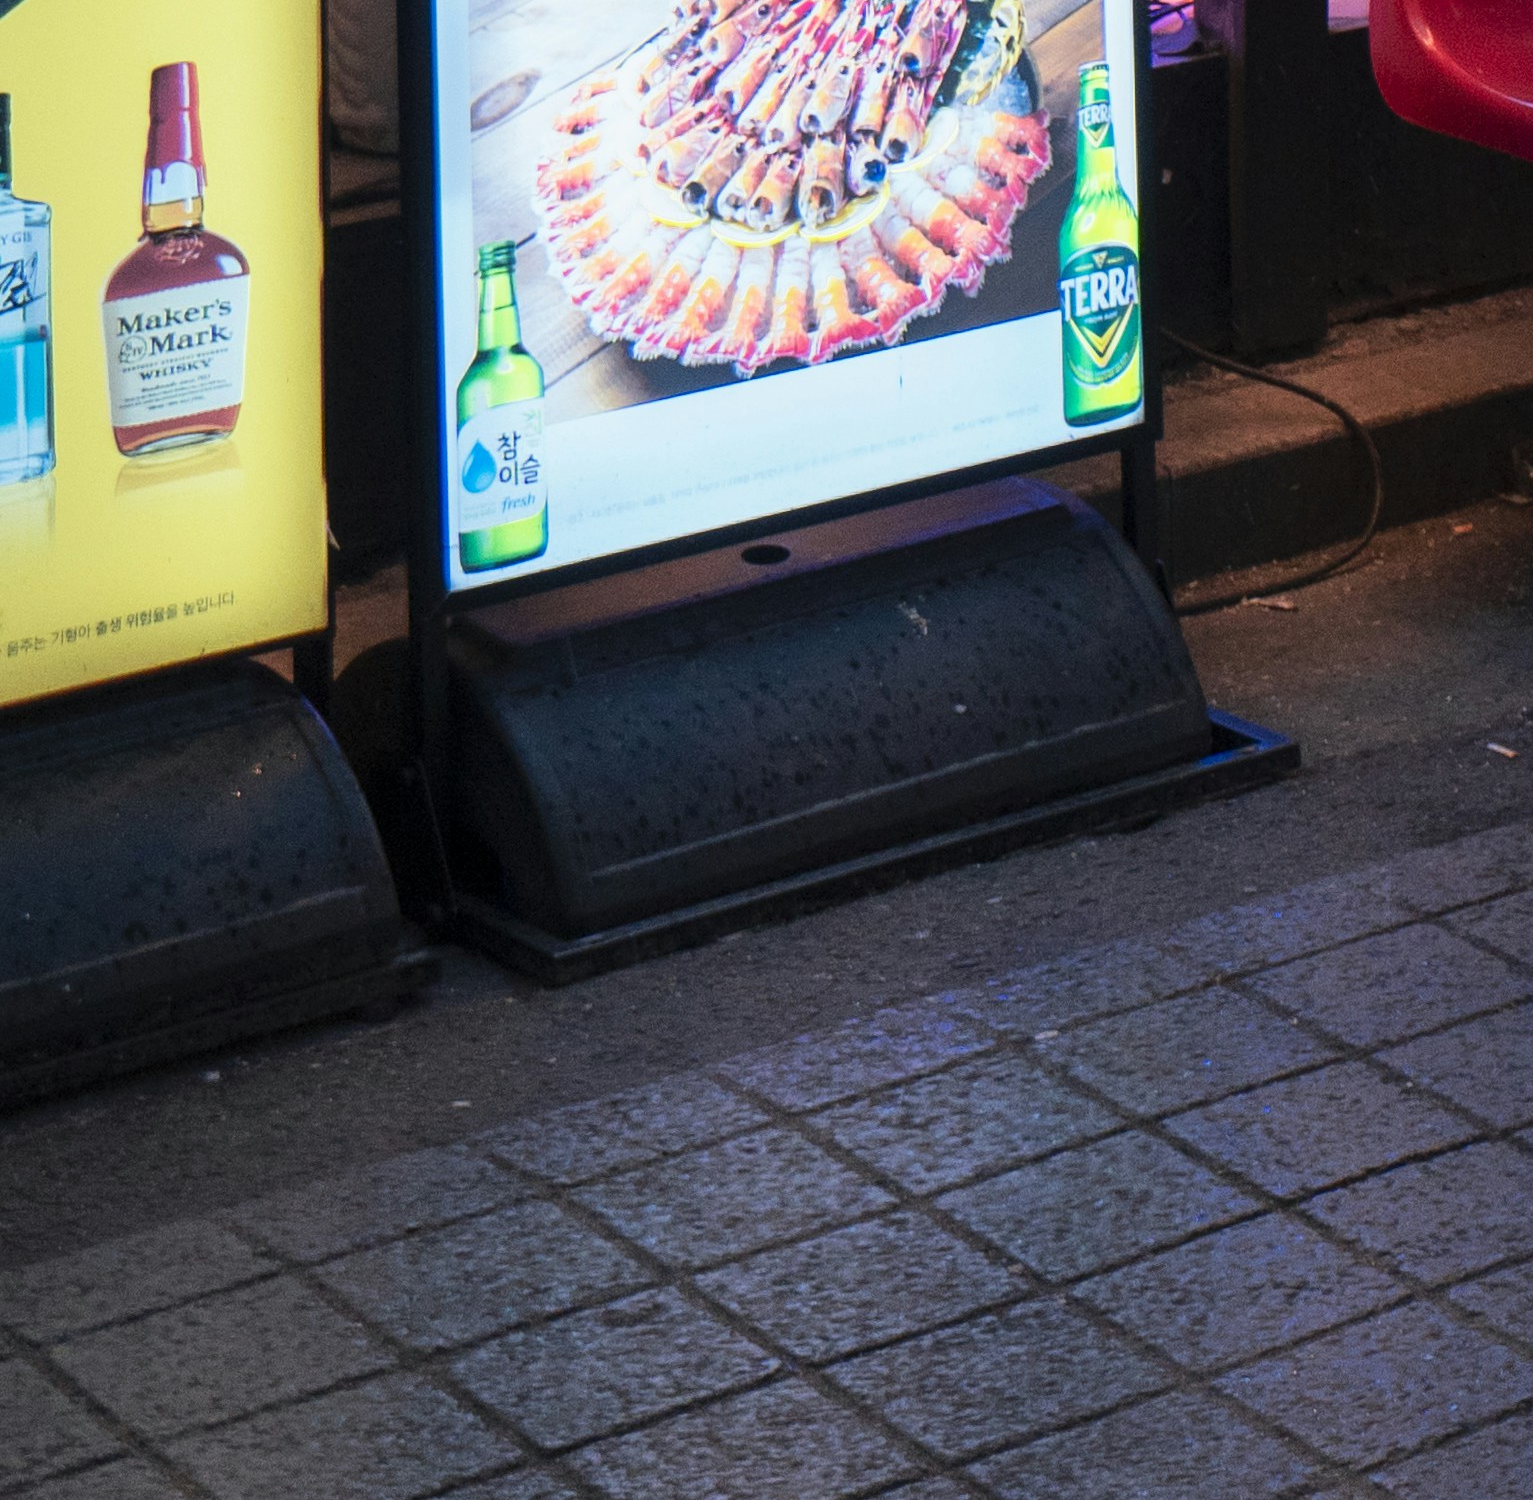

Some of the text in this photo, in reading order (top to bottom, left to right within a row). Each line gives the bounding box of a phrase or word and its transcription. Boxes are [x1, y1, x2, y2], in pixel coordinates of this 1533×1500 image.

[1060, 264, 1139, 323] TERRA
[116, 298, 233, 337] Maker's
[149, 323, 231, 356] Mark
[139, 357, 214, 381] WHISKY
[498, 432, 521, 461] 참
[500, 452, 540, 486] 이슬
[501, 492, 536, 514] fresh
[51, 623, 91, 646] 기형아
